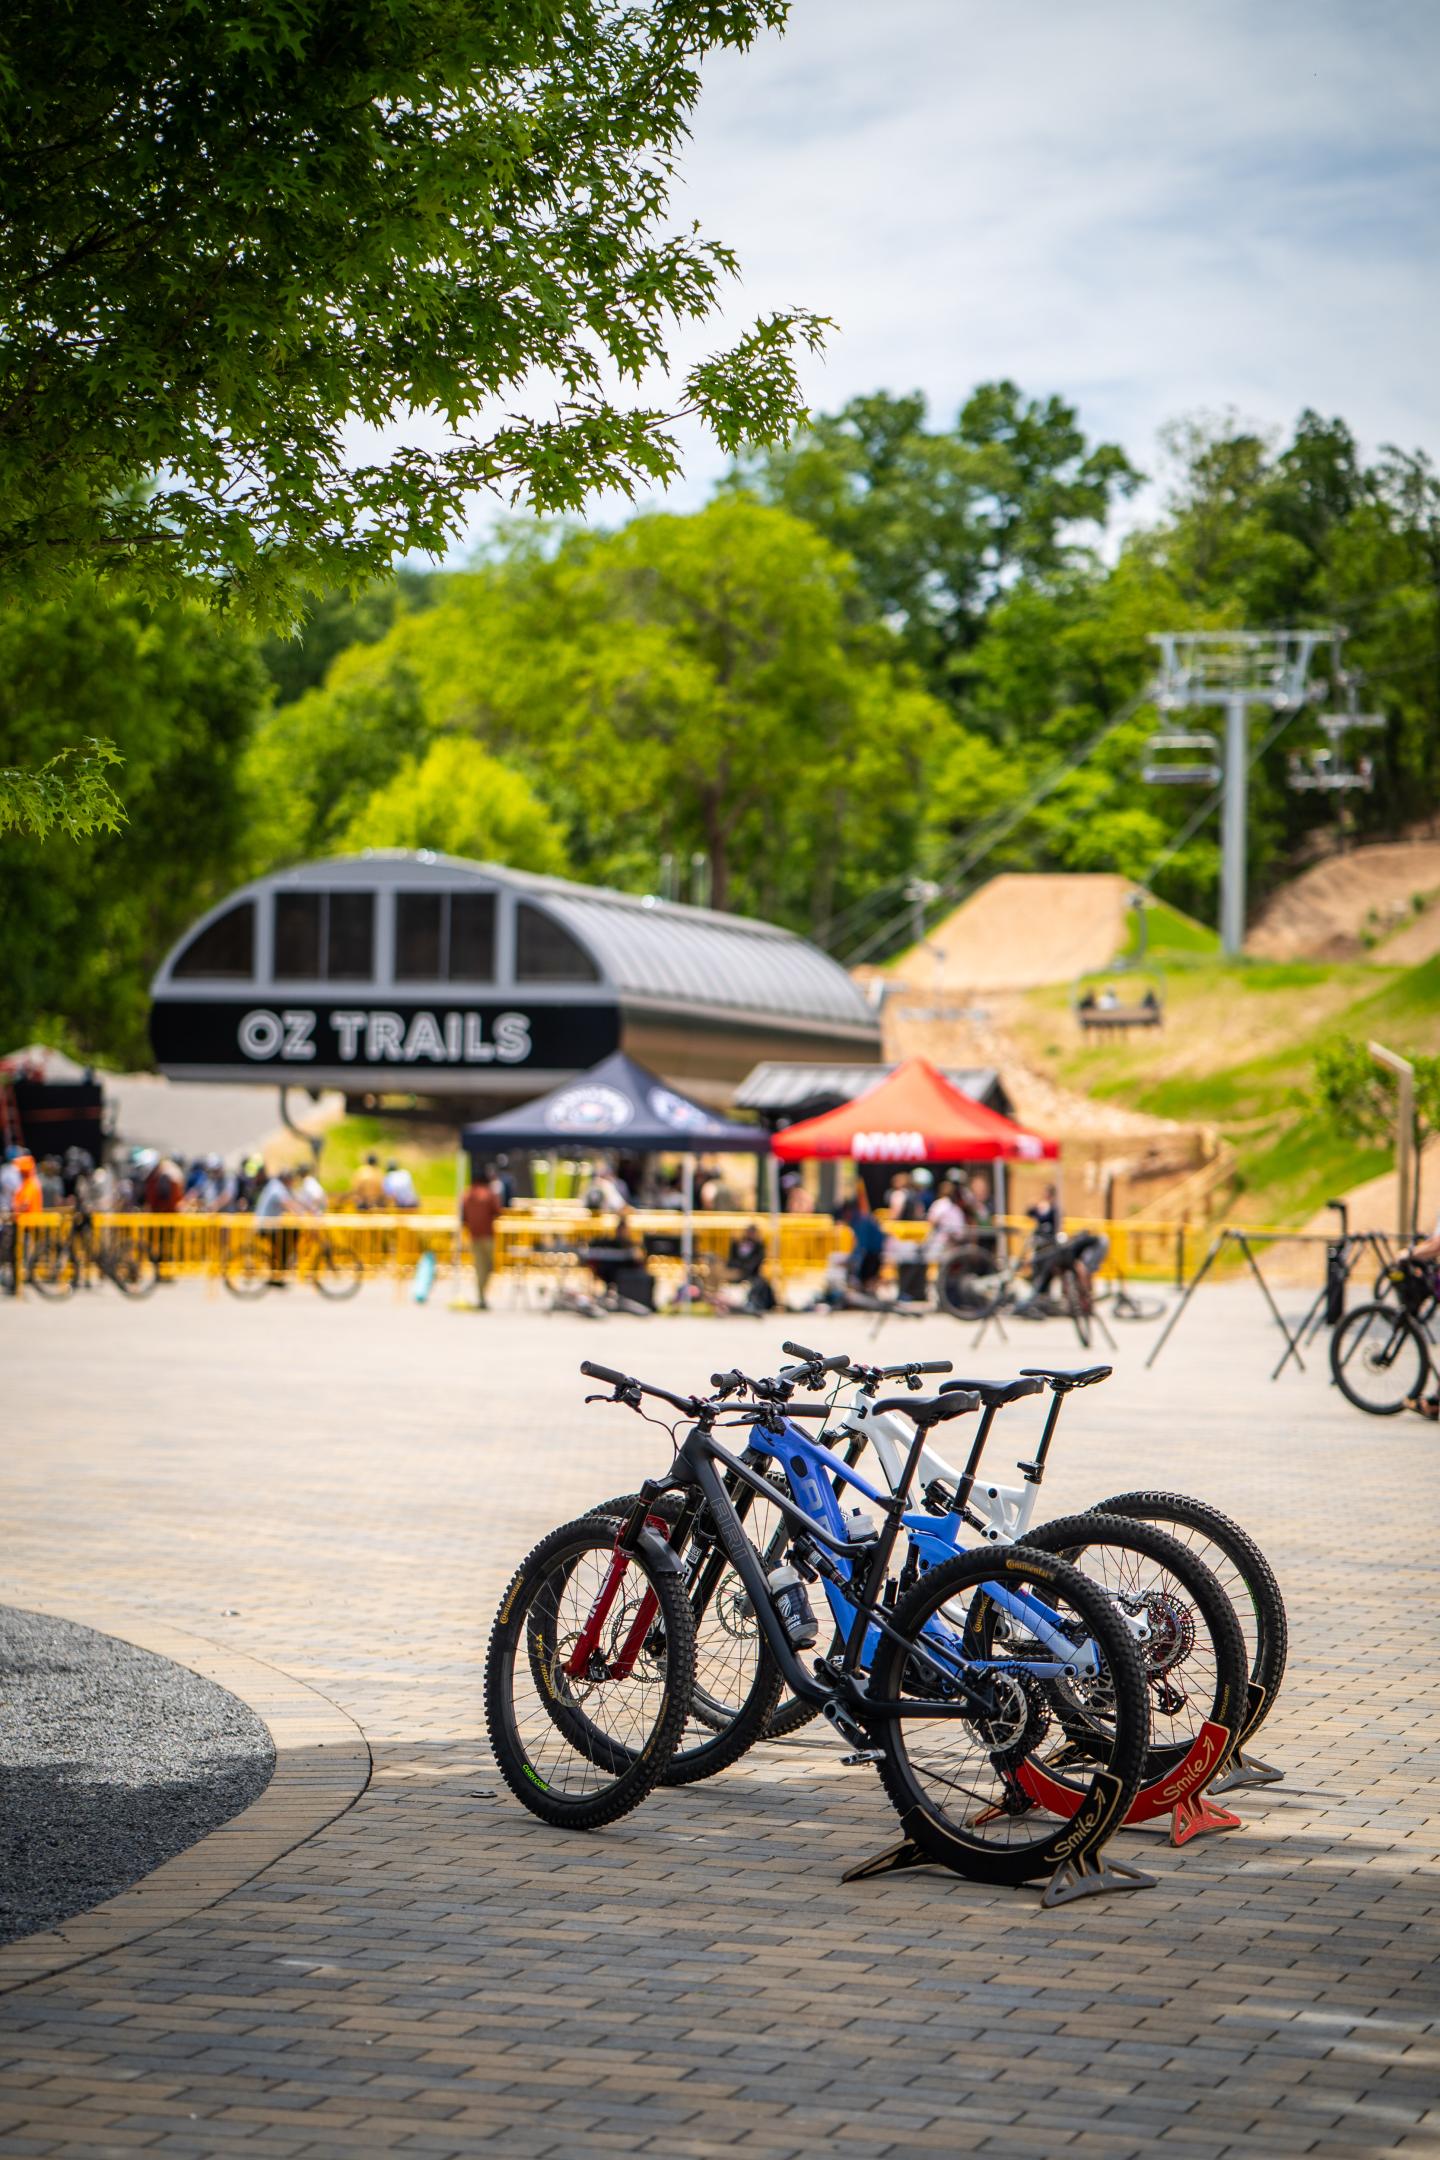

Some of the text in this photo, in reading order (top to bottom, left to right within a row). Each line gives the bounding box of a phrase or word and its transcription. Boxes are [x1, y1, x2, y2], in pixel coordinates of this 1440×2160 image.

[238, 1009, 531, 1063] OZ TRAILS
[710, 1497, 750, 1561] ARI
[500, 1581, 522, 1624] Continental
[1153, 1758, 1211, 1804] Smile
[1044, 1813, 1099, 1862] Smile
